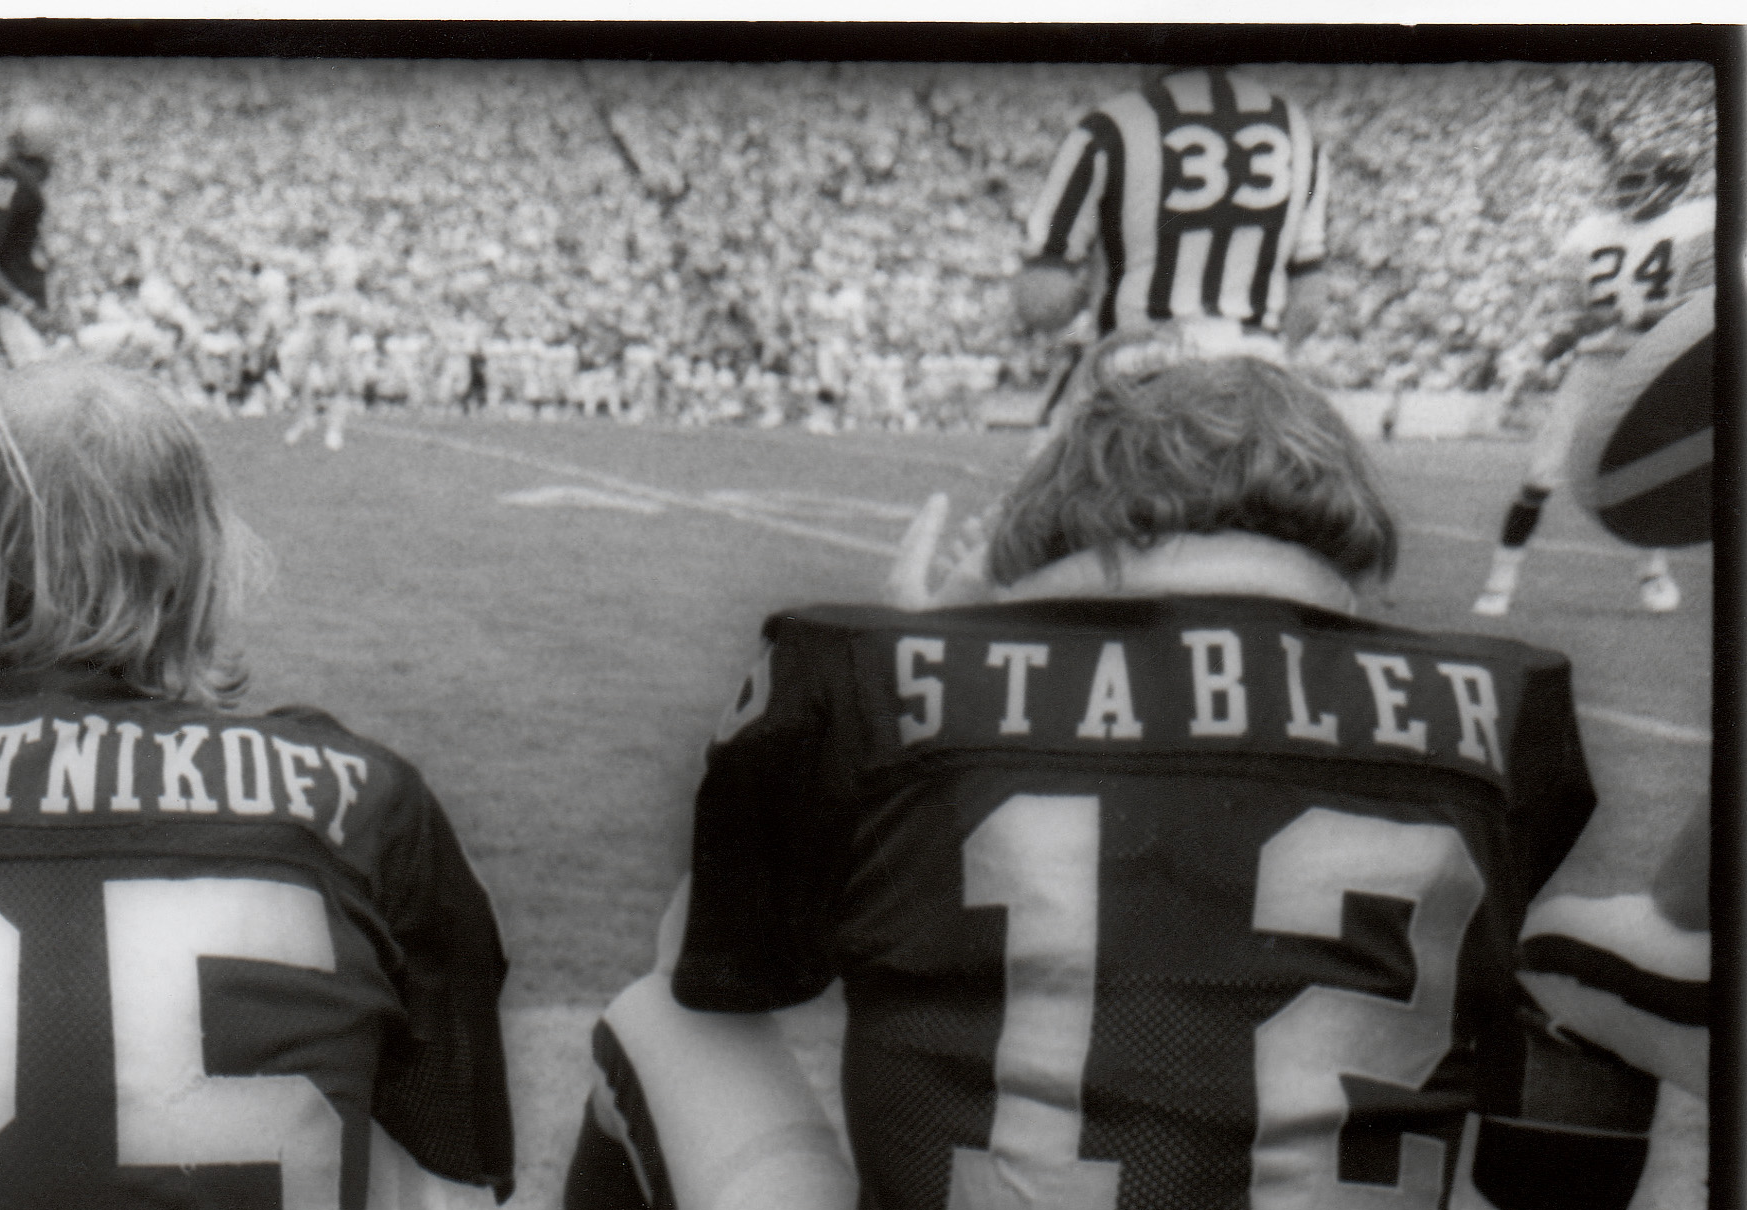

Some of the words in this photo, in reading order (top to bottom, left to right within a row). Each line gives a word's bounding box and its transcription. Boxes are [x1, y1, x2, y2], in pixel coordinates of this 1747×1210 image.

[1164, 124, 1292, 211] 33
[1589, 238, 1673, 305] 24
[895, 629, 1504, 776] STABLER
